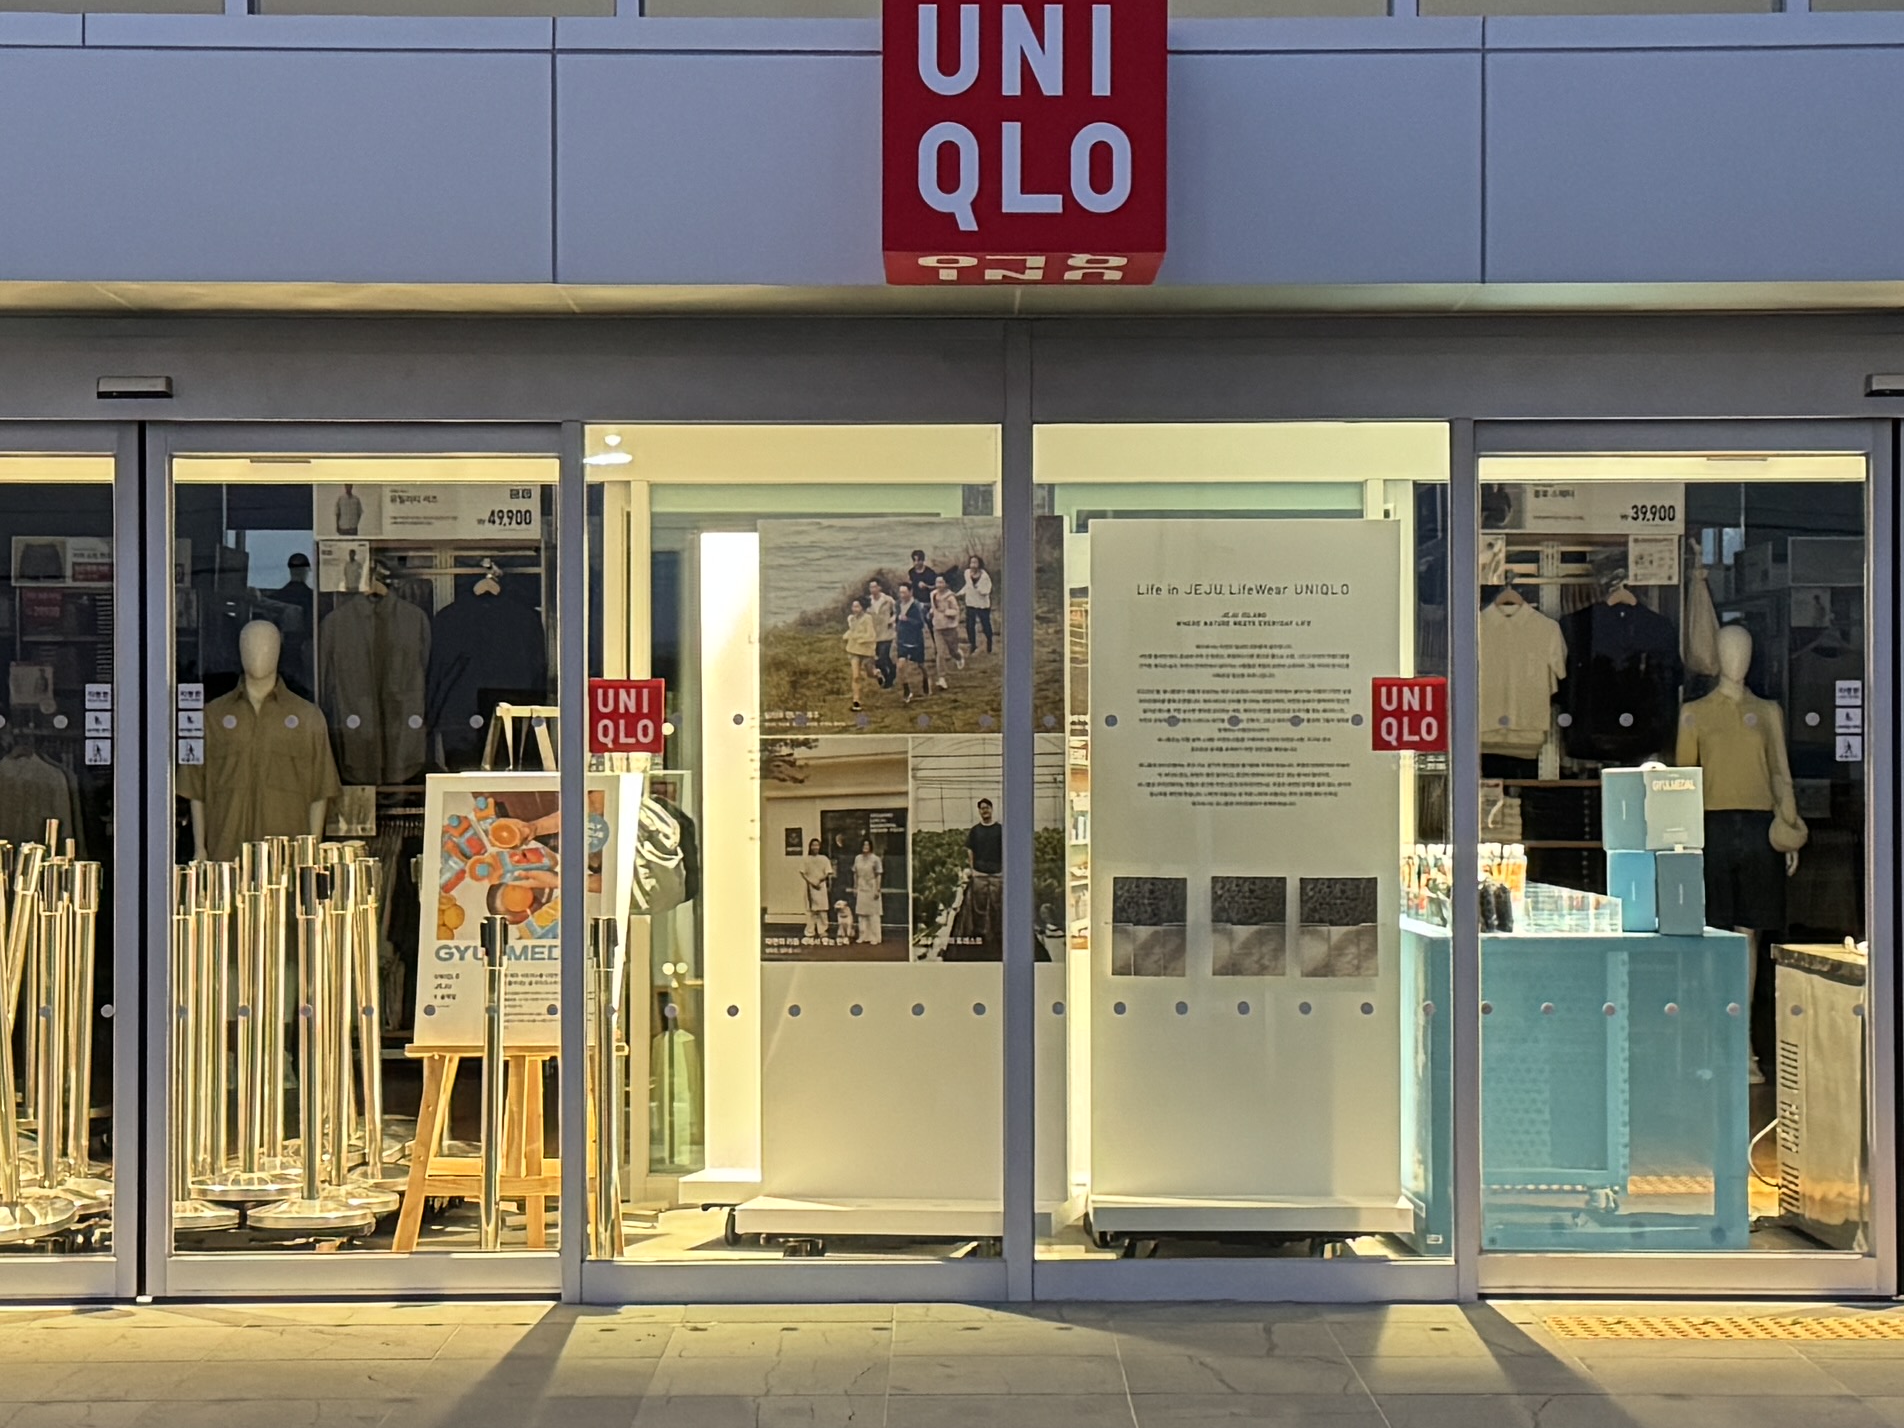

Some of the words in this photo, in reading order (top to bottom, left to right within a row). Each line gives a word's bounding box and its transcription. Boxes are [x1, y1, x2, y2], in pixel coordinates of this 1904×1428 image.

[917, 4, 1112, 97] UNI
[917, 121, 1133, 232] QLO
[1137, 583, 1162, 596] Life
[1168, 583, 1179, 596] in
[1229, 583, 1288, 596] LifeWear
[1294, 583, 1350, 596] UNIQLO
[597, 688, 649, 714] UNI
[1380, 686, 1432, 712] UNI
[597, 718, 654, 748] QLO
[1380, 716, 1438, 746] QLO
